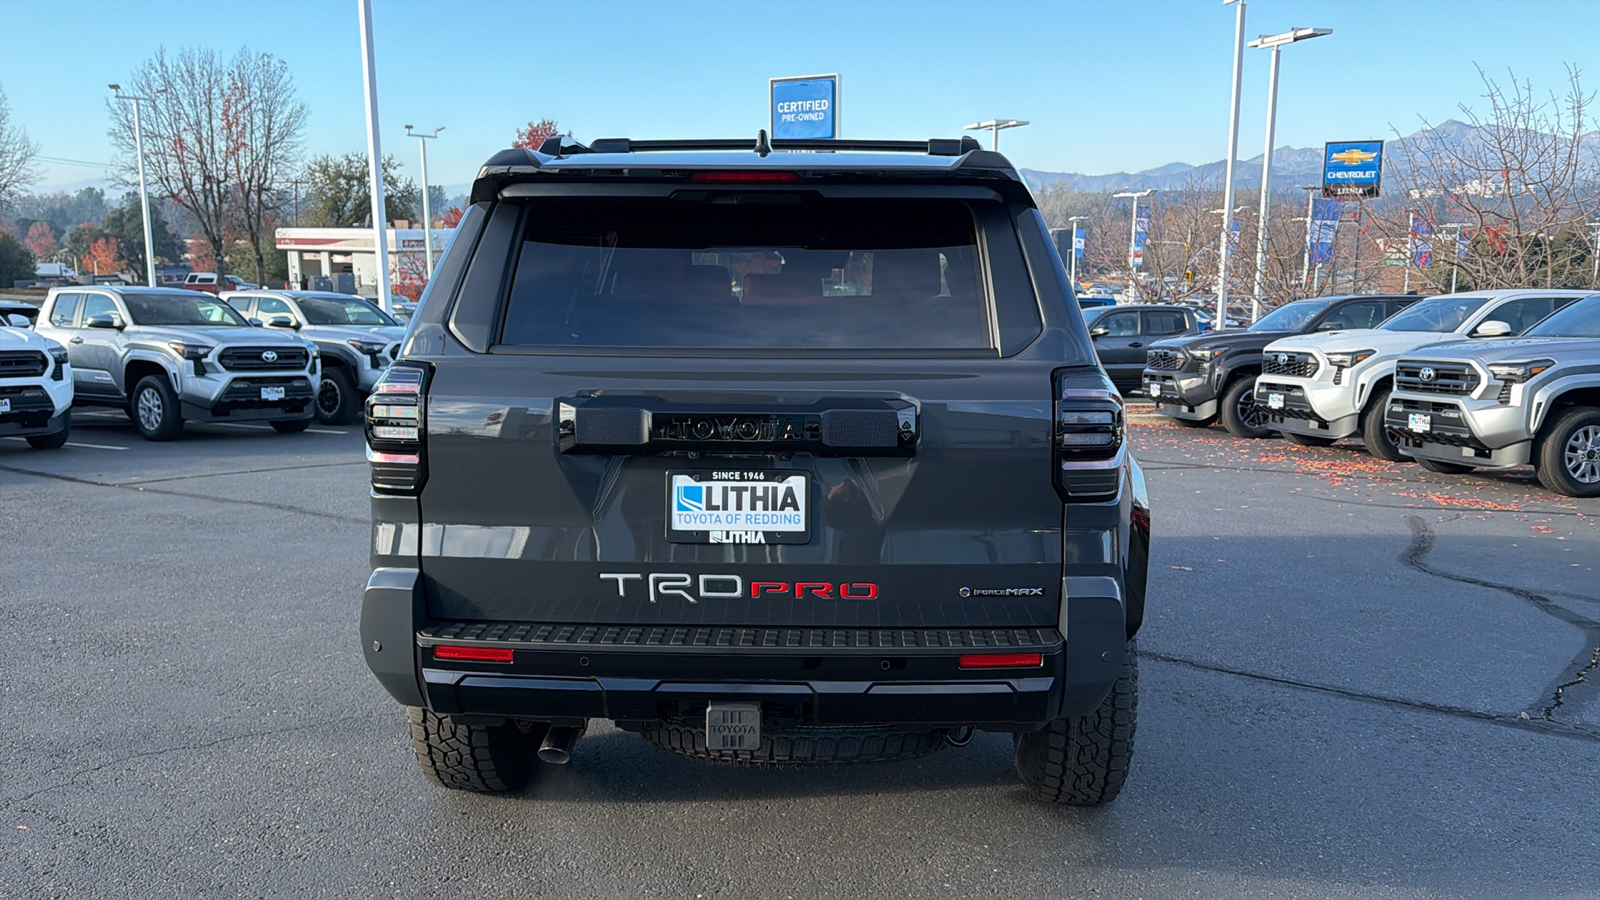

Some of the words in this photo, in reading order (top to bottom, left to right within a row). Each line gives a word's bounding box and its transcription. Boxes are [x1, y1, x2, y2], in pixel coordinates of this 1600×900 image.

[777, 100, 829, 113] CERTIFIED
[781, 112, 825, 122] PRE-OWNED
[1327, 170, 1377, 179] CHEVROLET
[672, 418, 801, 440] TOYOTA
[712, 471, 741, 480] SINCE
[743, 472, 765, 480] 1946
[705, 486, 800, 511] LITHIA
[677, 513, 722, 525] TOYOTA
[725, 513, 742, 525] OF
[745, 514, 801, 525] REDDING
[722, 530, 766, 544] LITHIA
[599, 573, 743, 604] TRD
[750, 581, 880, 600] PRO
[710, 724, 756, 735] TOYOTA
